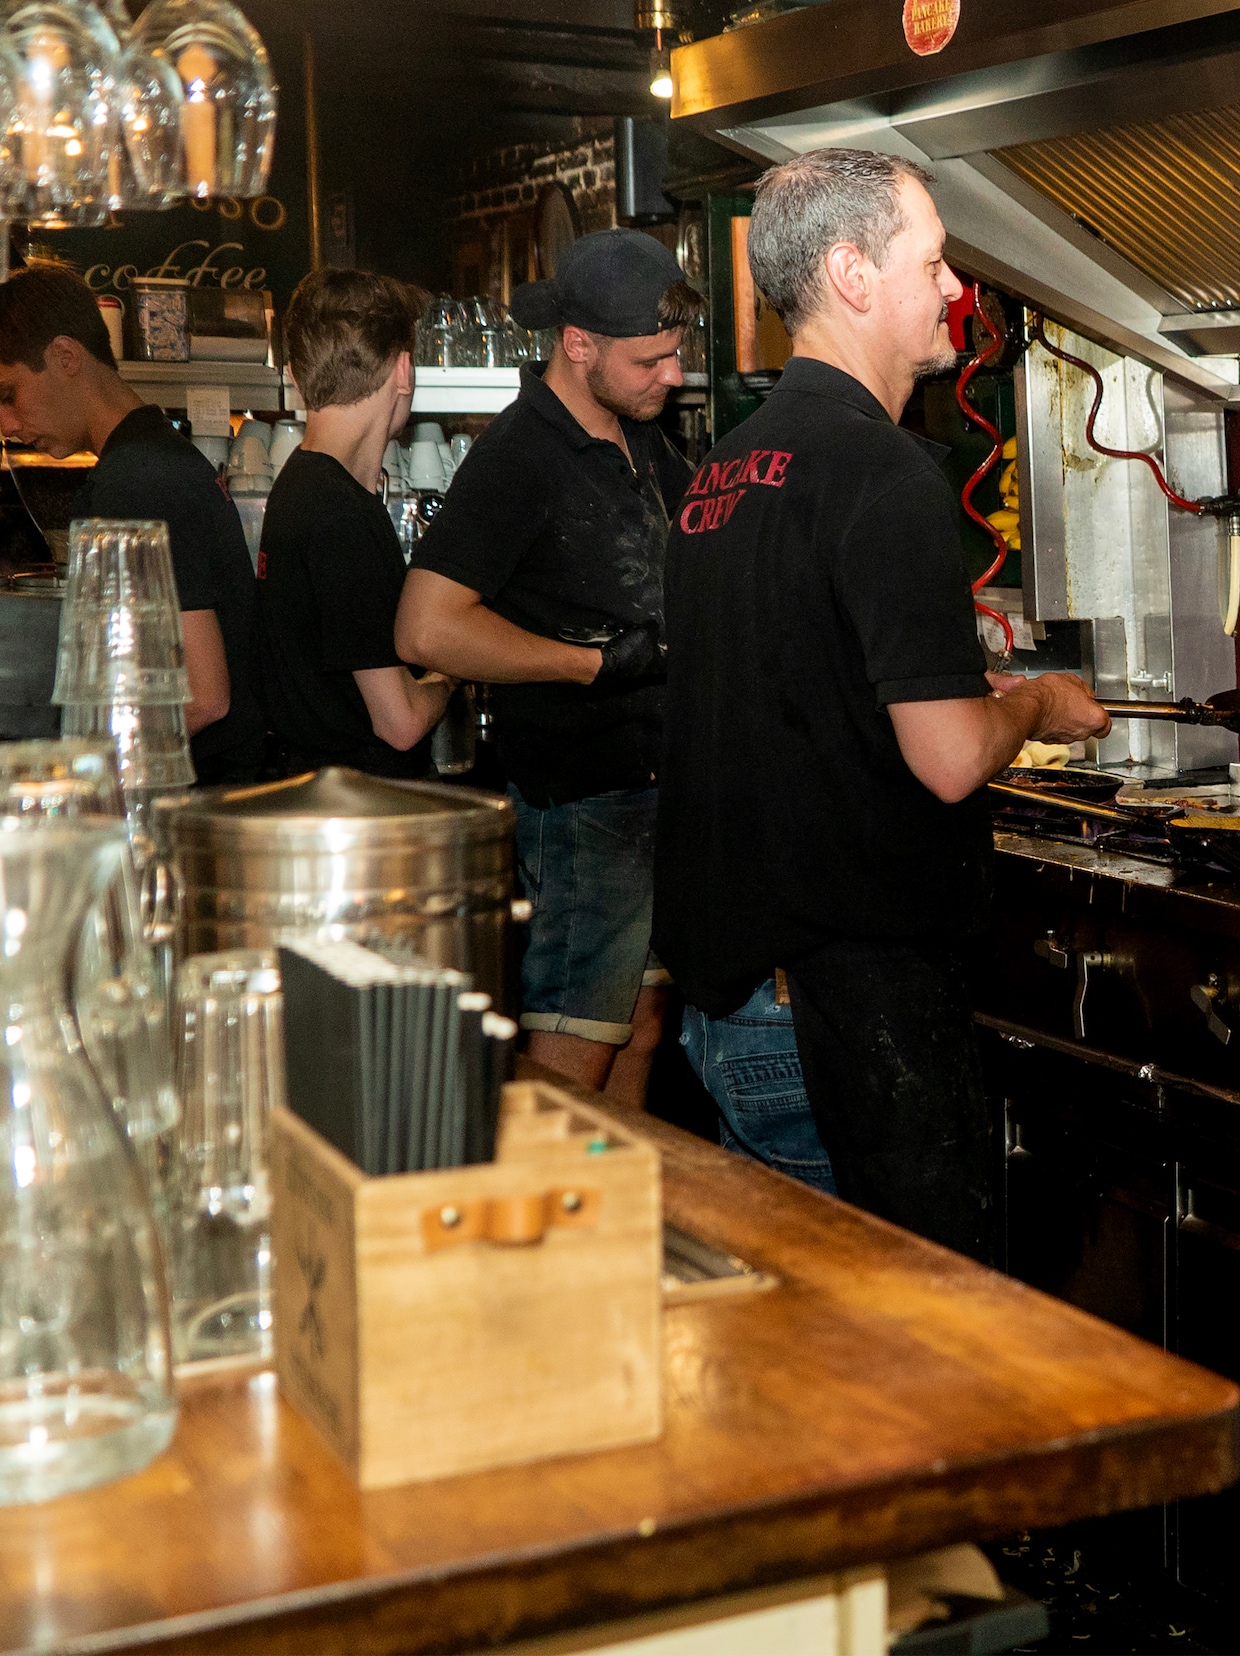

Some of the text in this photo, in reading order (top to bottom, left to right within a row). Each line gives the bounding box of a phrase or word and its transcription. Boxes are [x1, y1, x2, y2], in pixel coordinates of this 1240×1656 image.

[913, 14, 948, 35] BAKERY
[84, 240, 267, 291] coffee
[684, 450, 793, 497] ANCAKE
[680, 489, 748, 534] CREW
